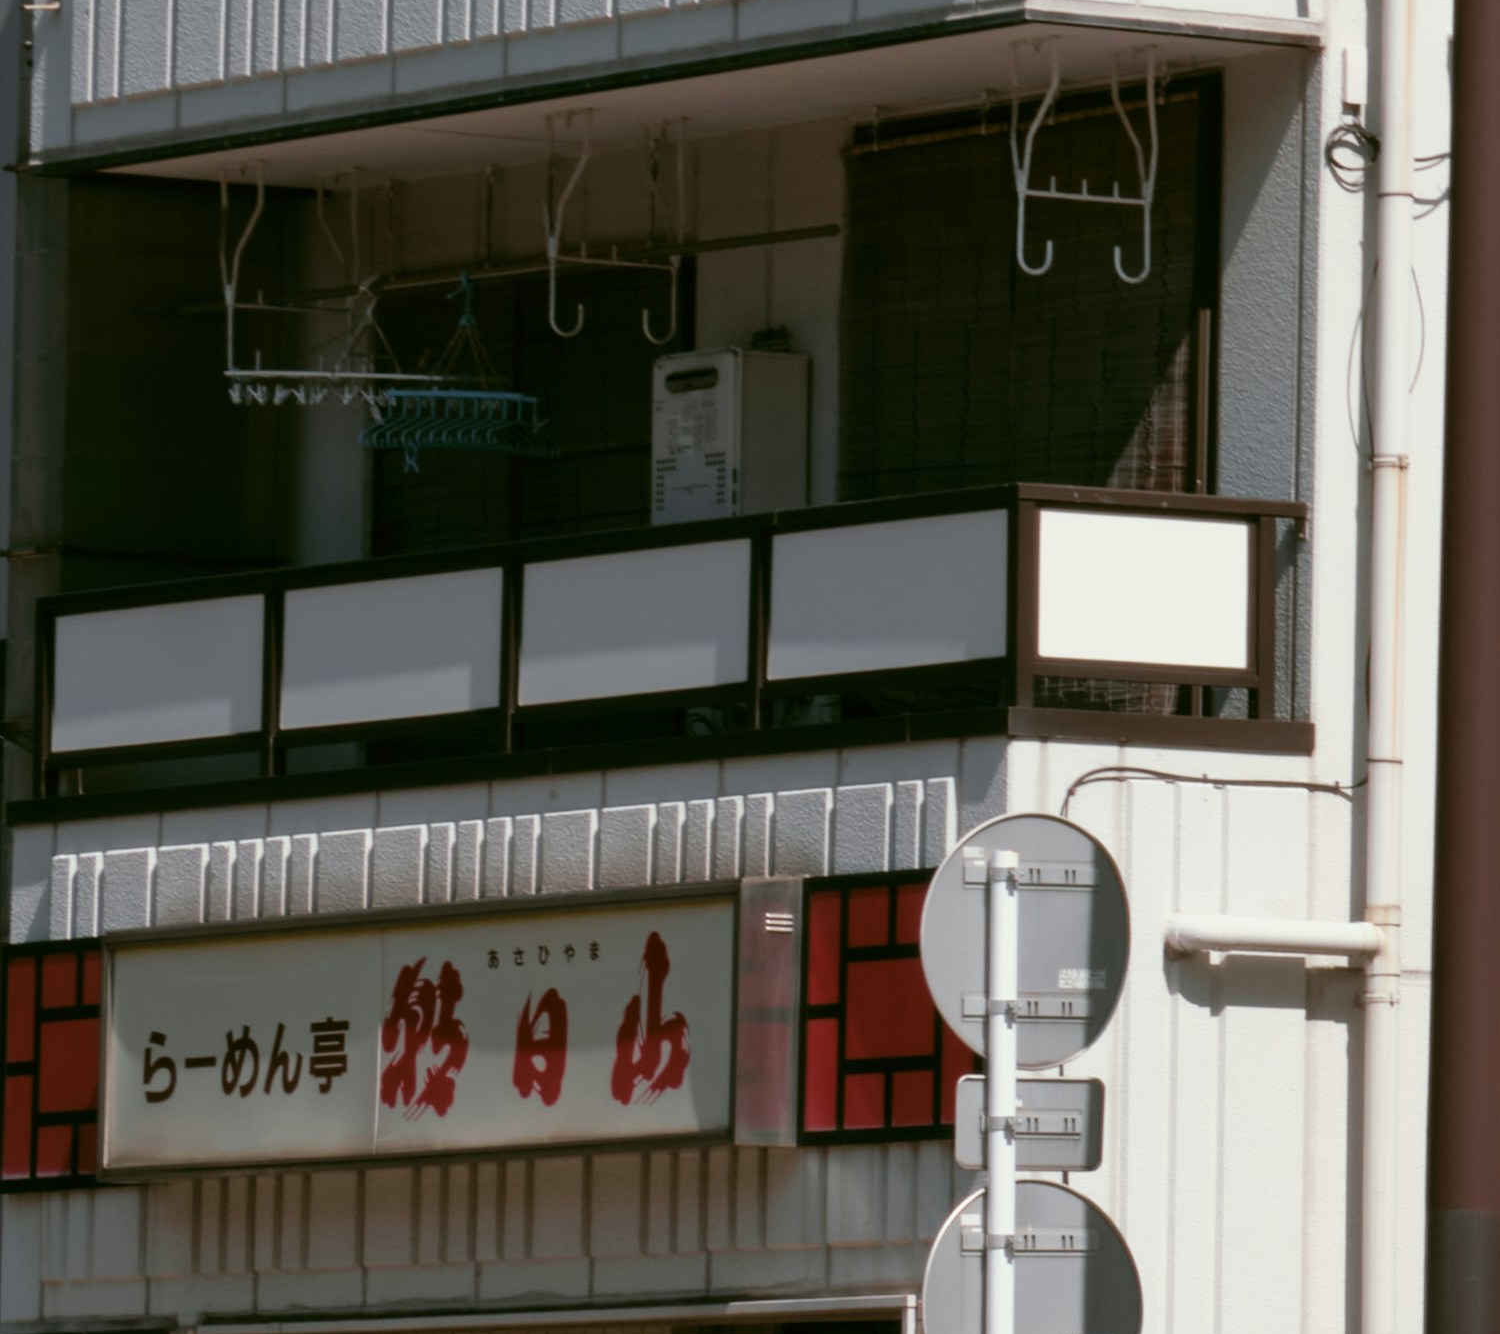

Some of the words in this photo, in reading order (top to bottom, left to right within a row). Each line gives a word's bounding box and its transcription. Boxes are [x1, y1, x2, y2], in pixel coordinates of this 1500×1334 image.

[486, 940, 601, 970] あさひやま
[141, 1016, 351, 1104] らーめん亭
